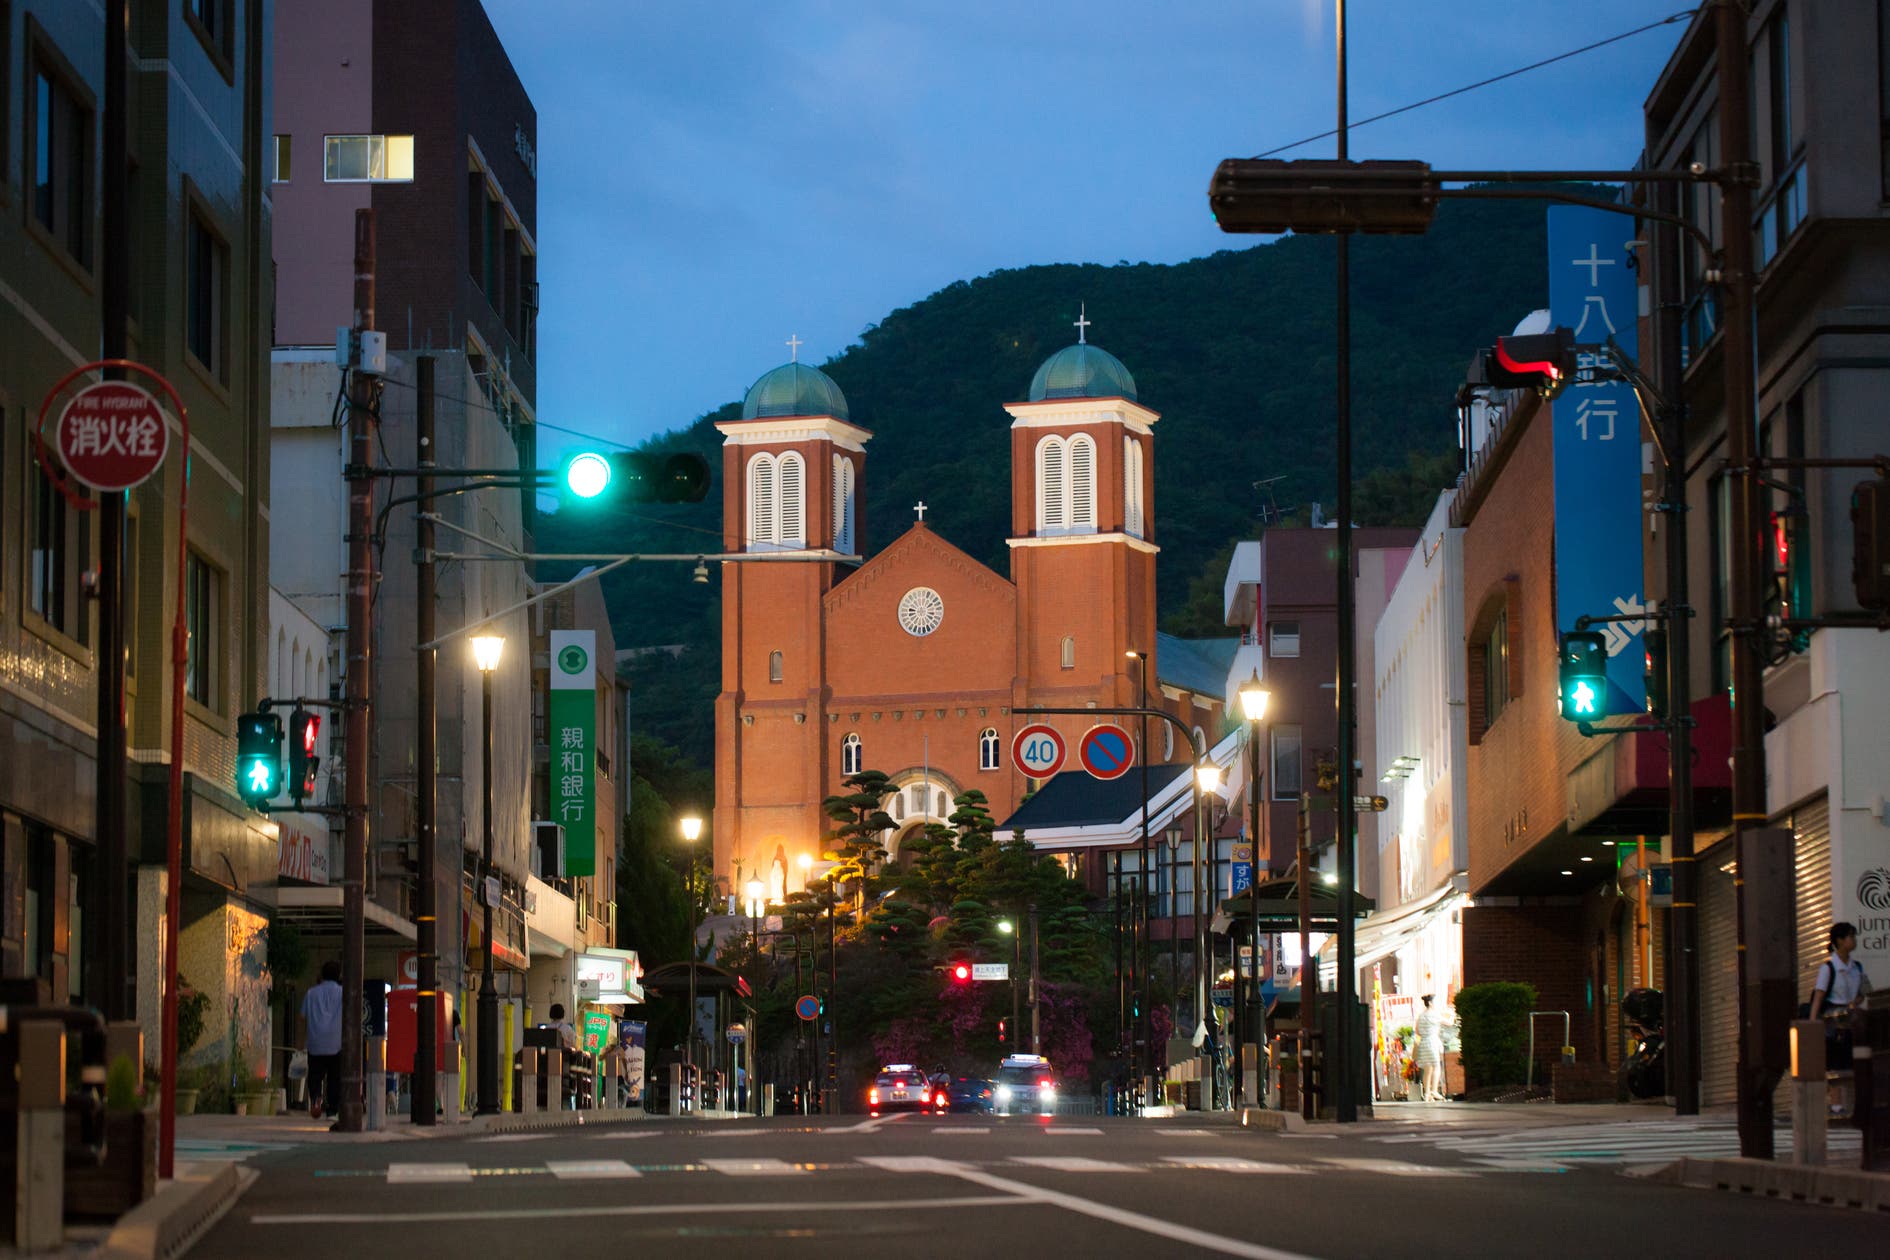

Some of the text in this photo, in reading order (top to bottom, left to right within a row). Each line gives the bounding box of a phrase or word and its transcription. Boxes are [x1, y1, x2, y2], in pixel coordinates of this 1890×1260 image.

[77, 396, 148, 410] FIRE HYDRANT
[70, 415, 159, 456] 消火栓
[1025, 740, 1054, 763] 40
[560, 727, 584, 821] 親和銀行
